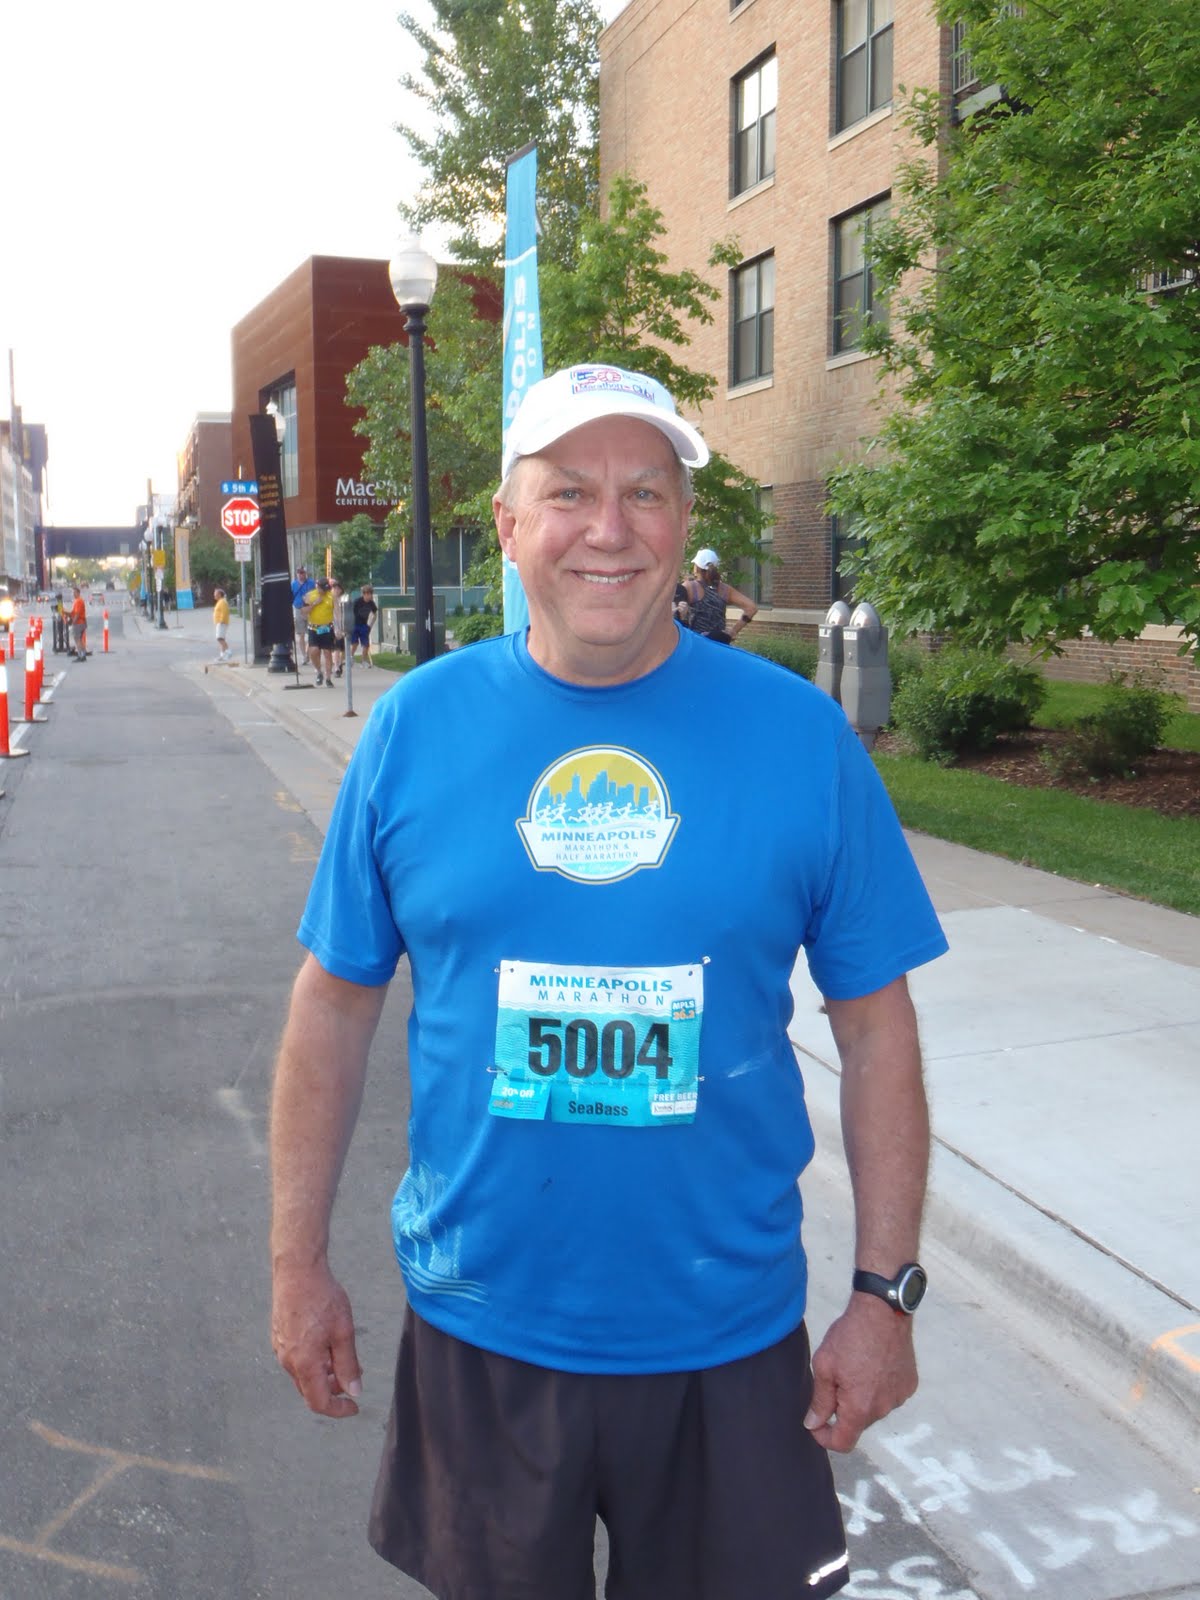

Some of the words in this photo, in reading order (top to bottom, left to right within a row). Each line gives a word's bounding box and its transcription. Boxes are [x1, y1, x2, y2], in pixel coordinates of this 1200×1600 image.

[223, 483, 230, 493] S
[232, 482, 247, 493] 5th
[336, 498, 369, 506] CENTER
[224, 509, 260, 527] STOP
[541, 829, 657, 842] MINNEAPOLIS
[564, 843, 619, 851] MARATHON
[556, 852, 580, 861] HALF
[584, 851, 639, 860] MARATHON
[529, 974, 673, 992] MINNEAPOLIS
[537, 990, 665, 1006] MARATHON
[672, 1000, 695, 1010] MPLS
[528, 1017, 673, 1080] 5004
[653, 1093, 675, 1102] FREE
[677, 1092, 698, 1101] BEER
[568, 1100, 629, 1116] SeaBass
